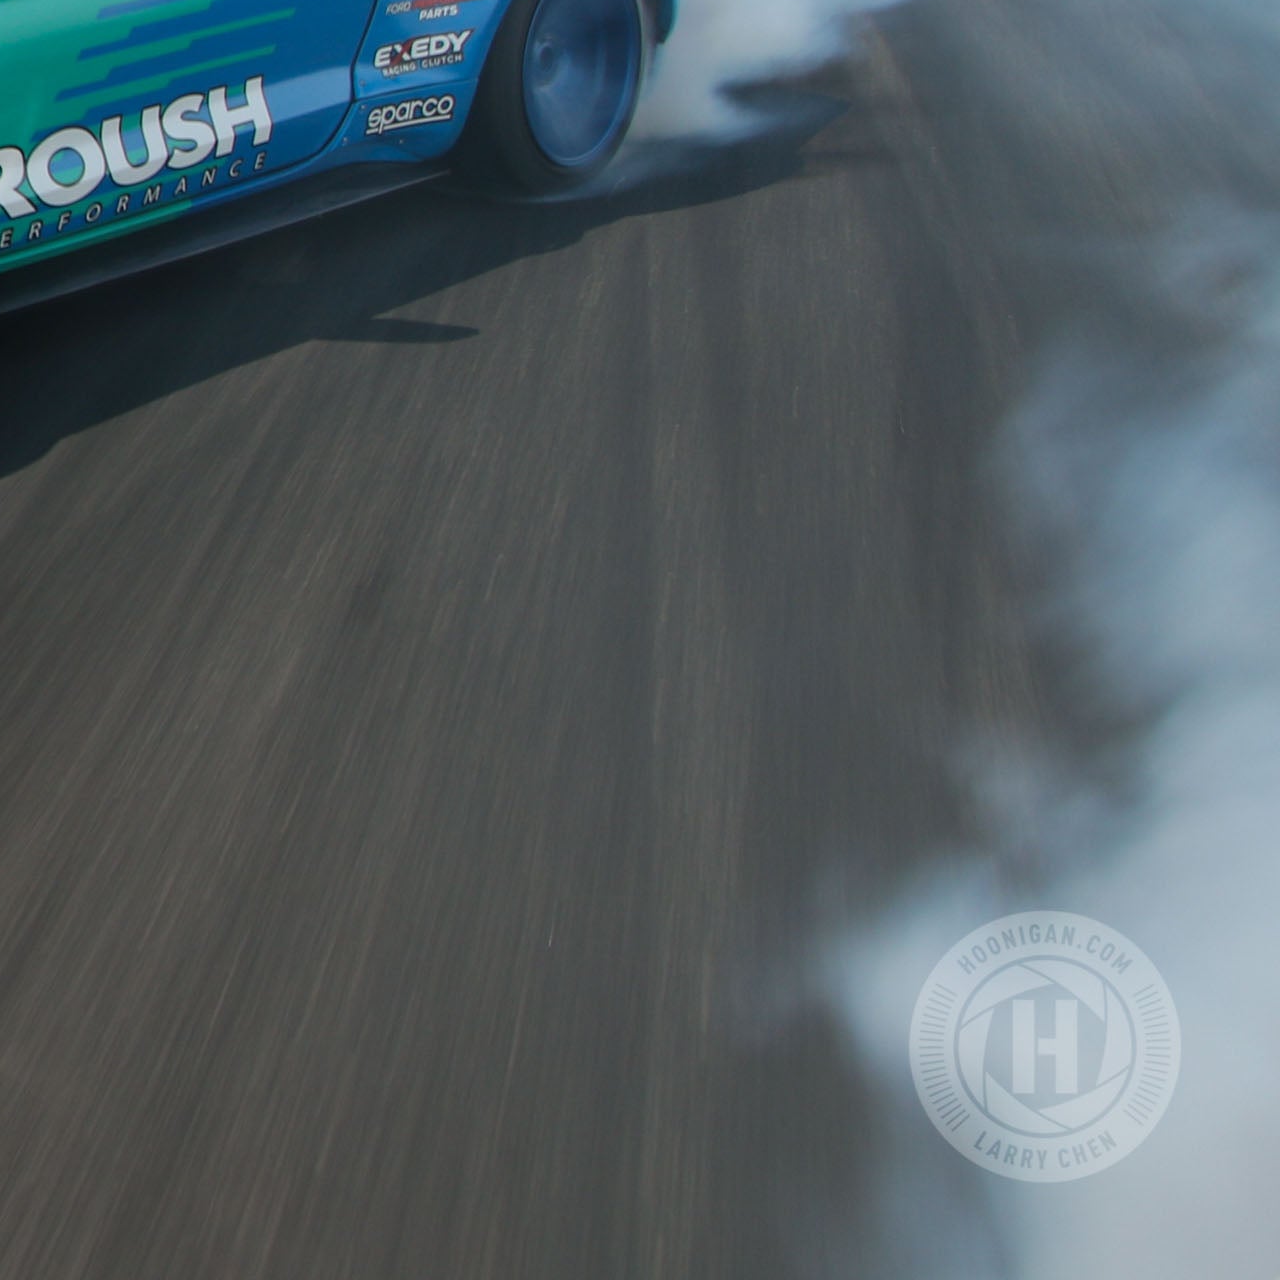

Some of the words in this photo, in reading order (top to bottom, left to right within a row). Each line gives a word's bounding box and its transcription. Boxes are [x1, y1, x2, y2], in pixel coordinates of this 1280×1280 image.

[419, 5, 458, 21] PARTS
[374, 28, 474, 68] EXEDY
[382, 62, 417, 78] RACING
[421, 54, 463, 69] CLUTCH
[367, 95, 454, 134] sparco
